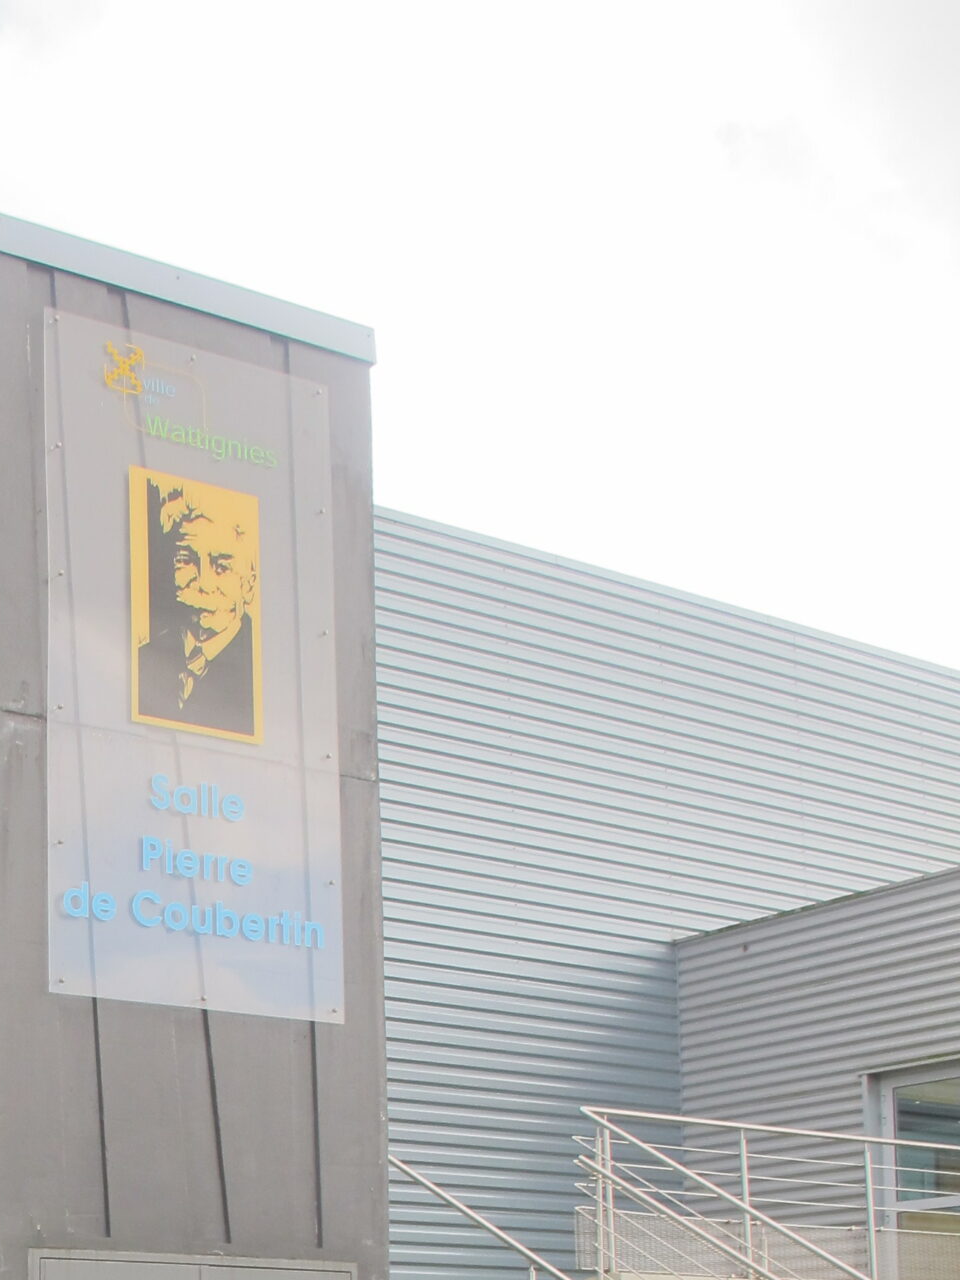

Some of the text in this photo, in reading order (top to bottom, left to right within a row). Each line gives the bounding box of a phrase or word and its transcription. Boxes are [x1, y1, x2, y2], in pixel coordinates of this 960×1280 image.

[143, 378, 177, 397] ville
[145, 415, 279, 468] Wattignies
[150, 773, 245, 822] Salle
[141, 836, 254, 886] Pierre
[63, 881, 324, 948] de Coubertin
